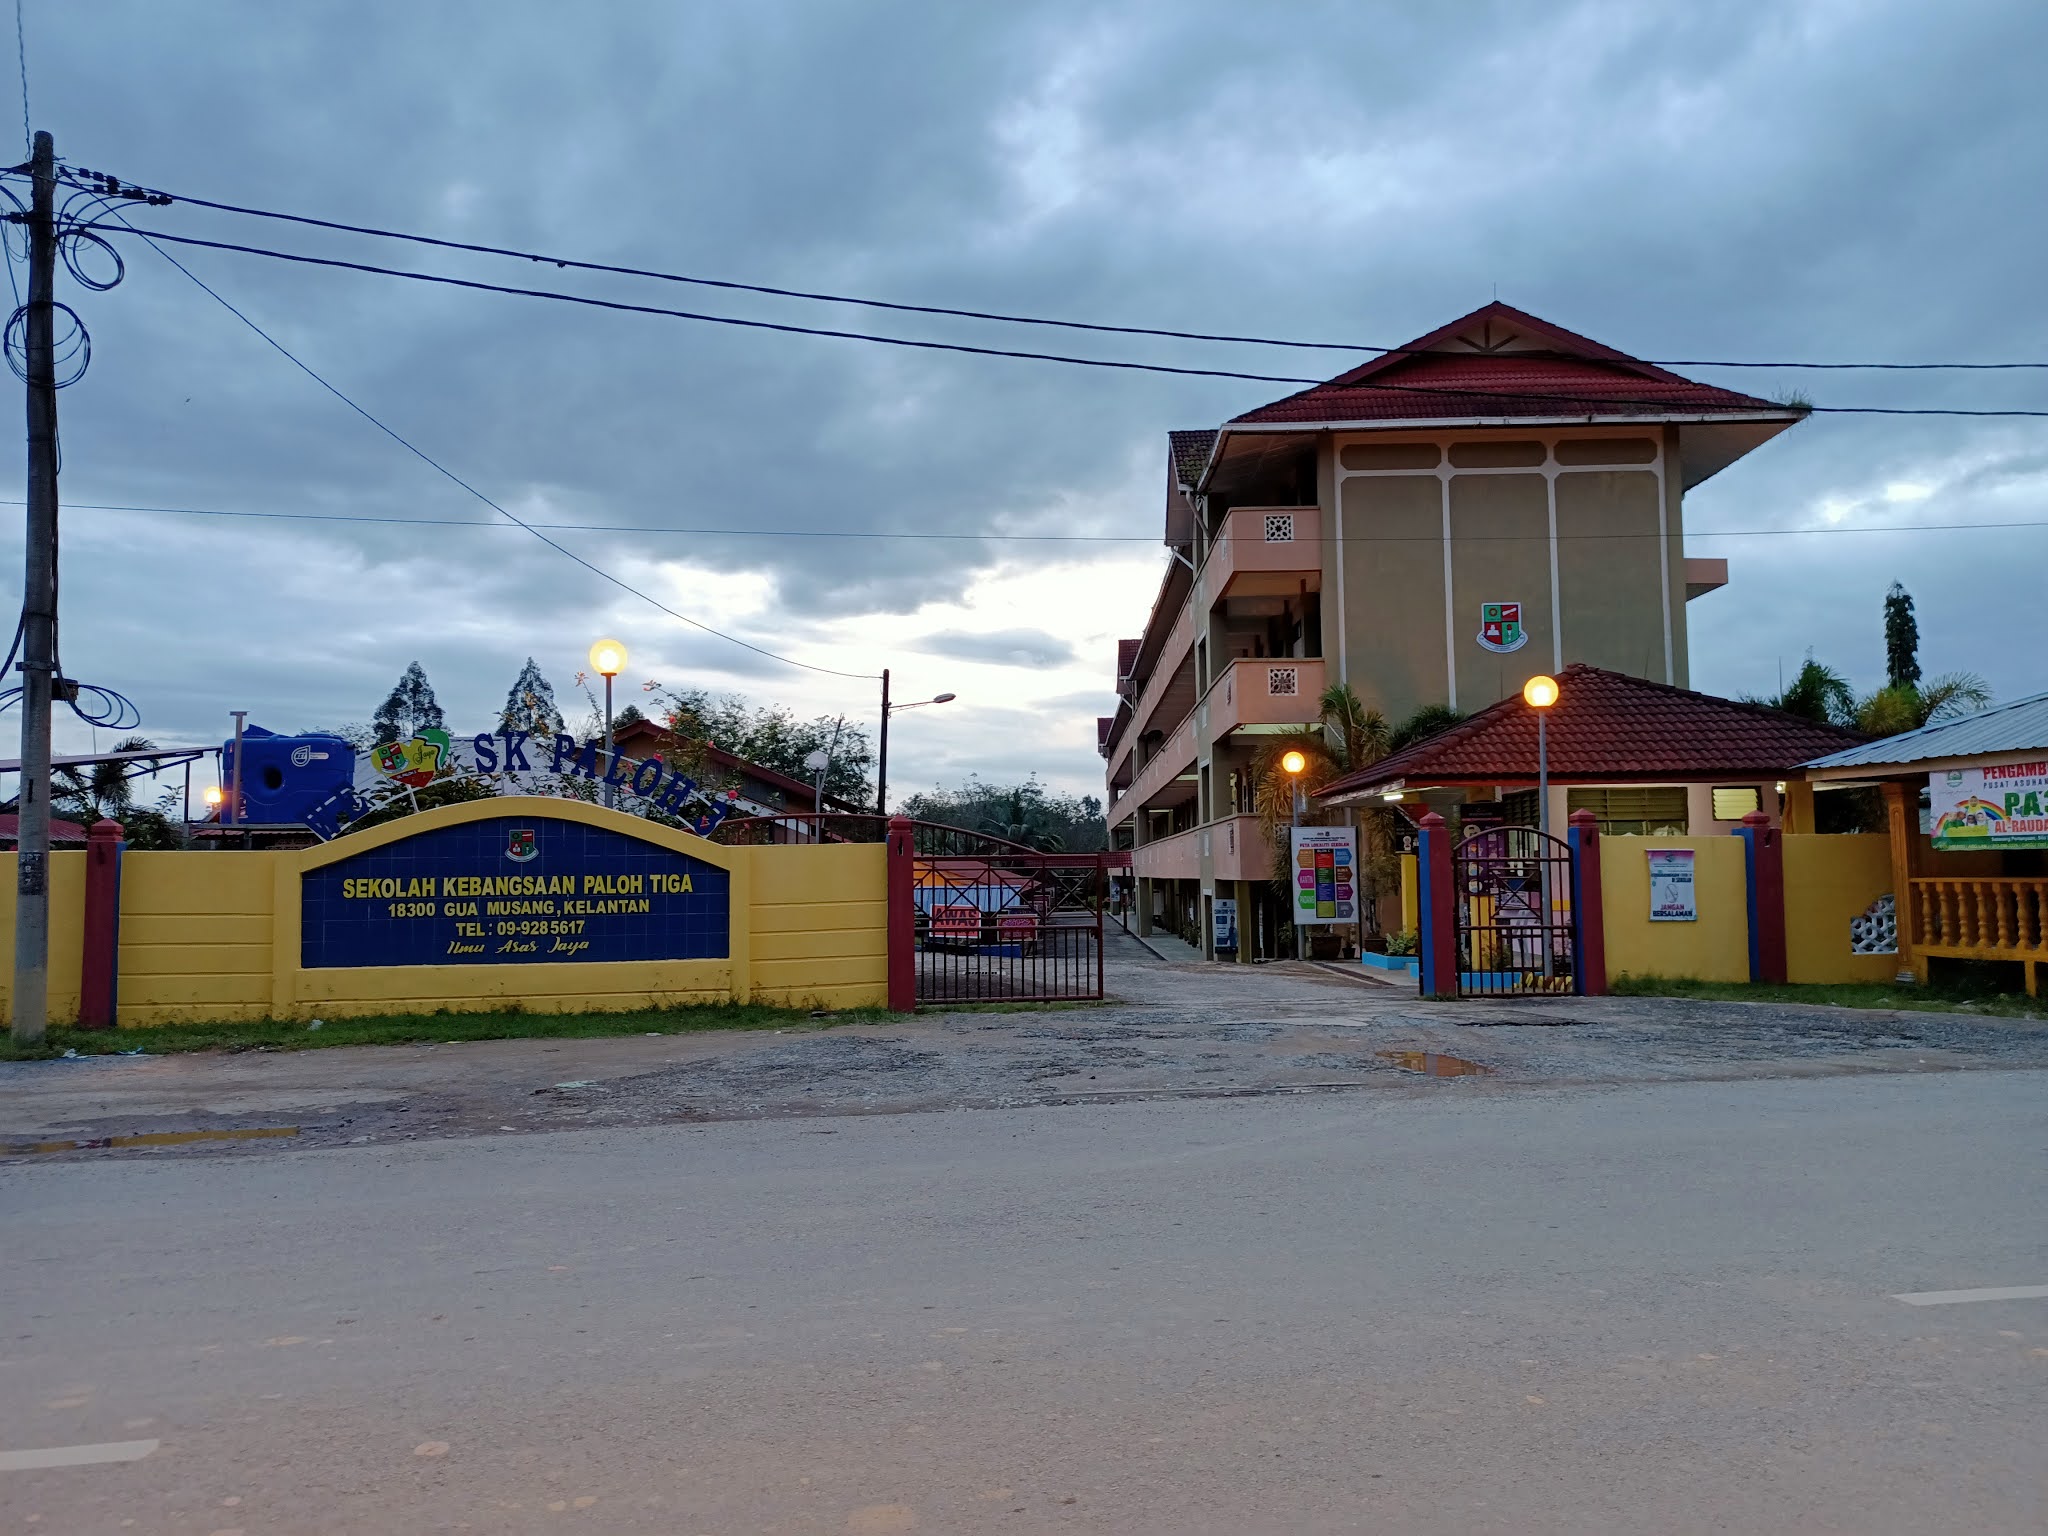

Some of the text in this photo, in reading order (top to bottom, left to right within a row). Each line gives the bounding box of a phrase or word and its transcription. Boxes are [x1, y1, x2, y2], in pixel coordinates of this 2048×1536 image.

[413, 745, 435, 765] Jaya
[473, 731, 531, 773] SK
[549, 733, 697, 816] PALOH
[1983, 780, 2009, 789] PUSAT
[343, 873, 693, 898] SEKOLAH KEBANGSAAN PALOH TIGA
[388, 902, 435, 918] 18300
[443, 902, 478, 917] GUA
[564, 899, 650, 914] KELANTAN
[934, 908, 977, 927] AWAS
[447, 936, 589, 956] Ilmu Asas Jaya
